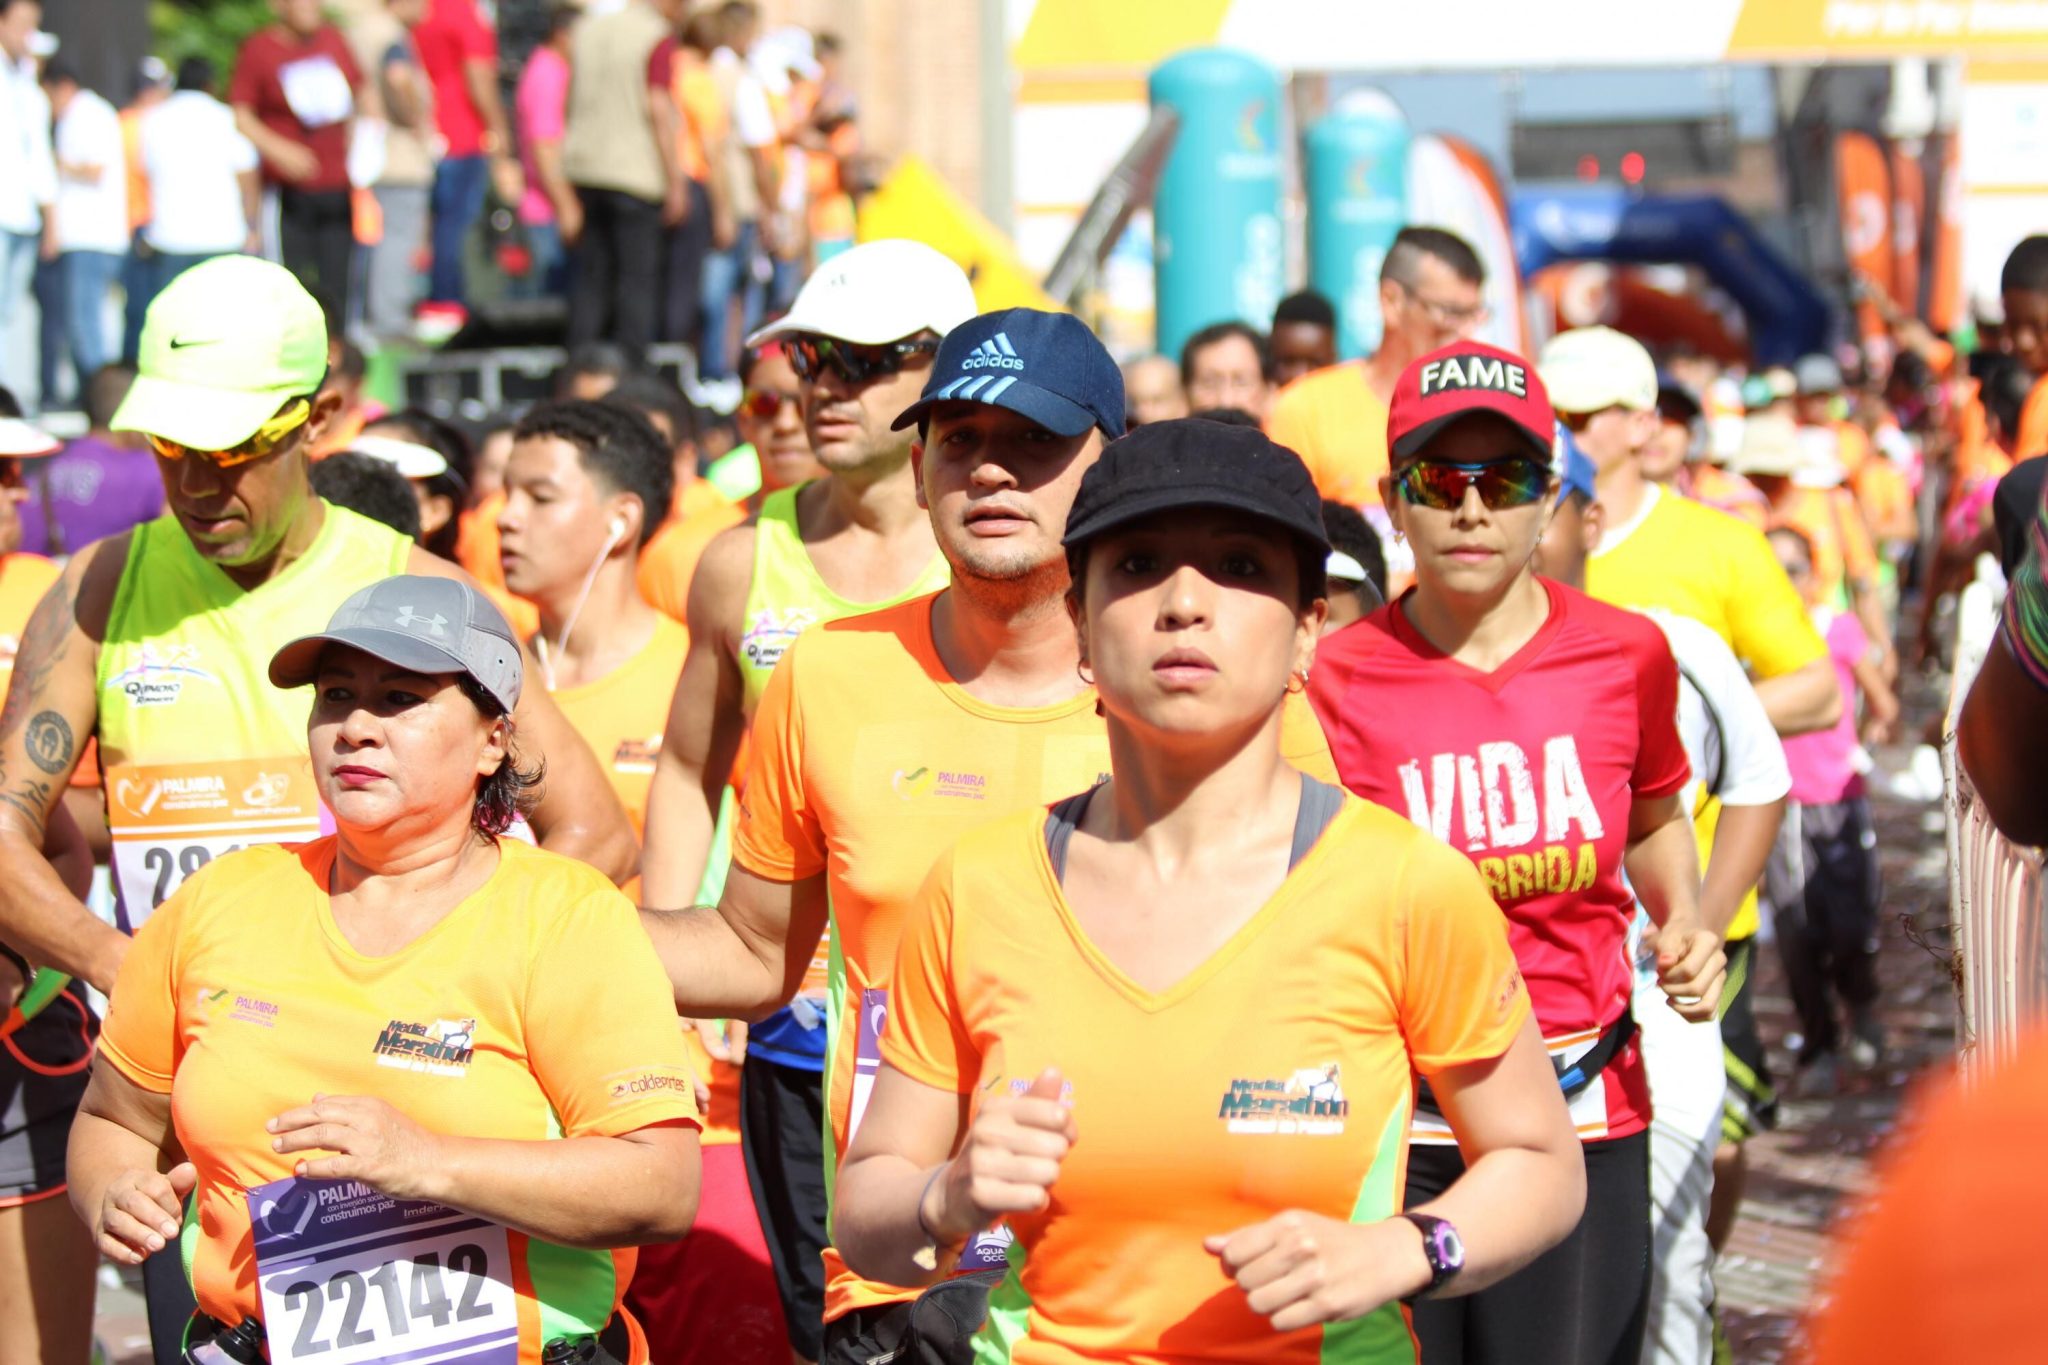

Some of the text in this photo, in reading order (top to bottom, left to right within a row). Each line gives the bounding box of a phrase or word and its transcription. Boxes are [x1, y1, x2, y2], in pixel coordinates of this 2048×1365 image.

[962, 353, 1024, 370] adidas
[1421, 356, 1526, 397] FAME
[162, 776, 226, 795] PALMIRA
[937, 772, 985, 787] PALMIRA
[1397, 734, 1604, 852] VIDA
[1479, 842, 1597, 900] RRIDA
[235, 996, 279, 1016] PALMIRA
[386, 1019, 428, 1037] Media
[373, 1030, 474, 1063] Marathon
[630, 1073, 686, 1093] coldeprtes
[1217, 1093, 1349, 1119] Marathon
[318, 1181, 377, 1206] PALMI
[320, 1200, 396, 1224] construimos paz
[327, 1204, 340, 1213] con
[403, 1204, 442, 1217] Imder
[983, 1254, 1006, 1263] OCC
[284, 1243, 494, 1358] 22142
